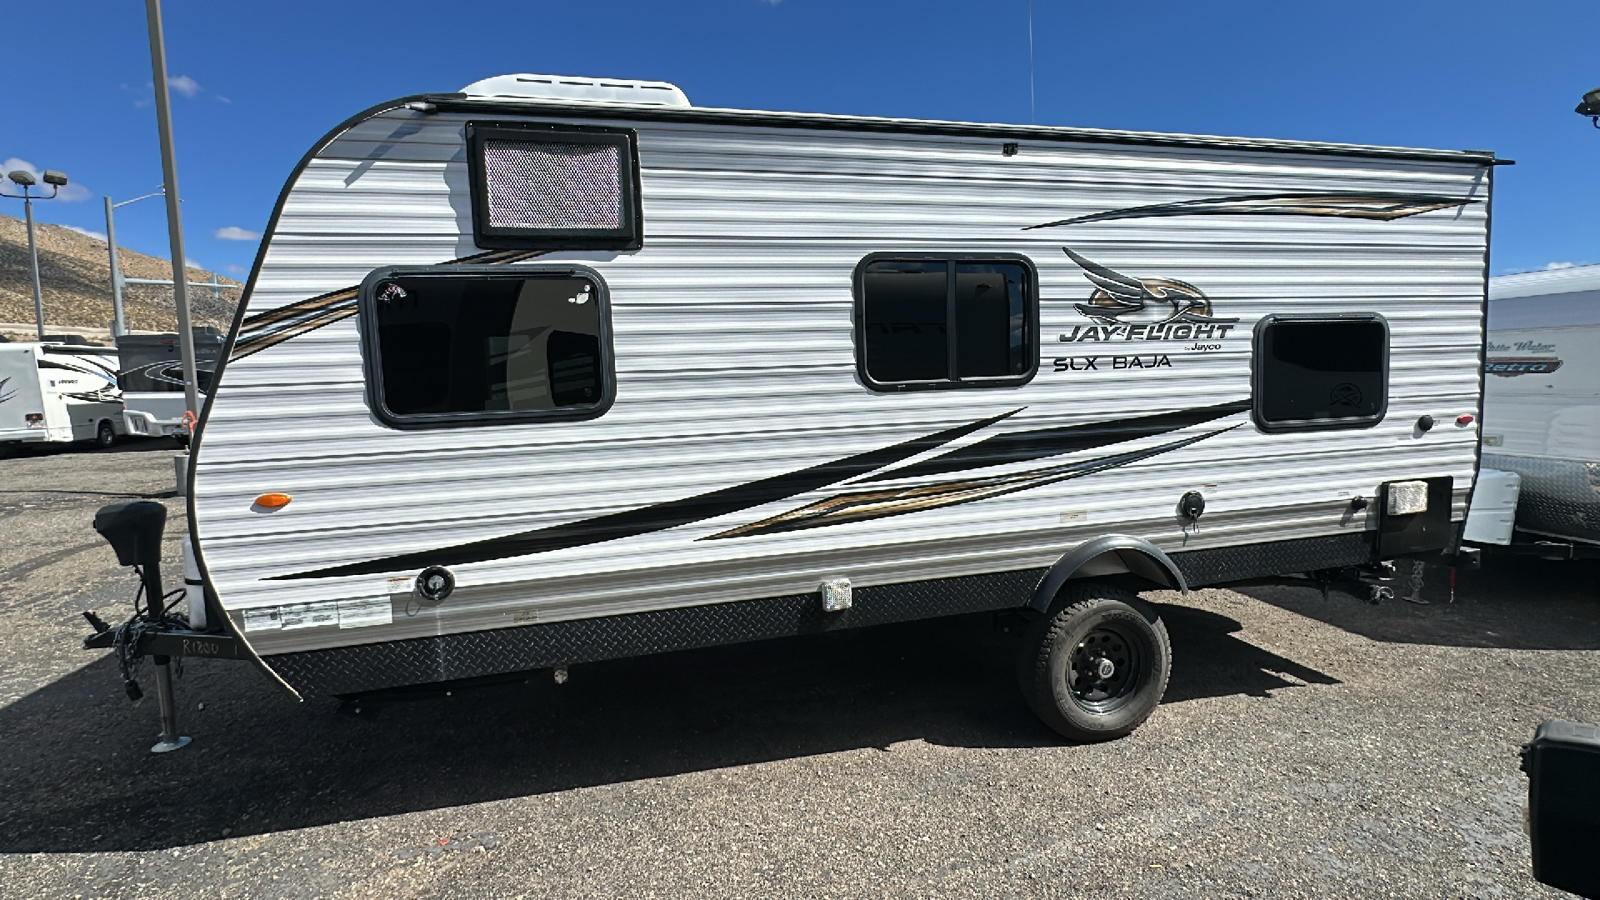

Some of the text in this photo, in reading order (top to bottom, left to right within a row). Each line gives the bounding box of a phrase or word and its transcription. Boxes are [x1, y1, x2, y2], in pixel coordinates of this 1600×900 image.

[1058, 324, 1235, 342] JAY FLIGHT
[1191, 342, 1222, 352] Jayco
[1053, 355, 1172, 372] SLX BAJA
